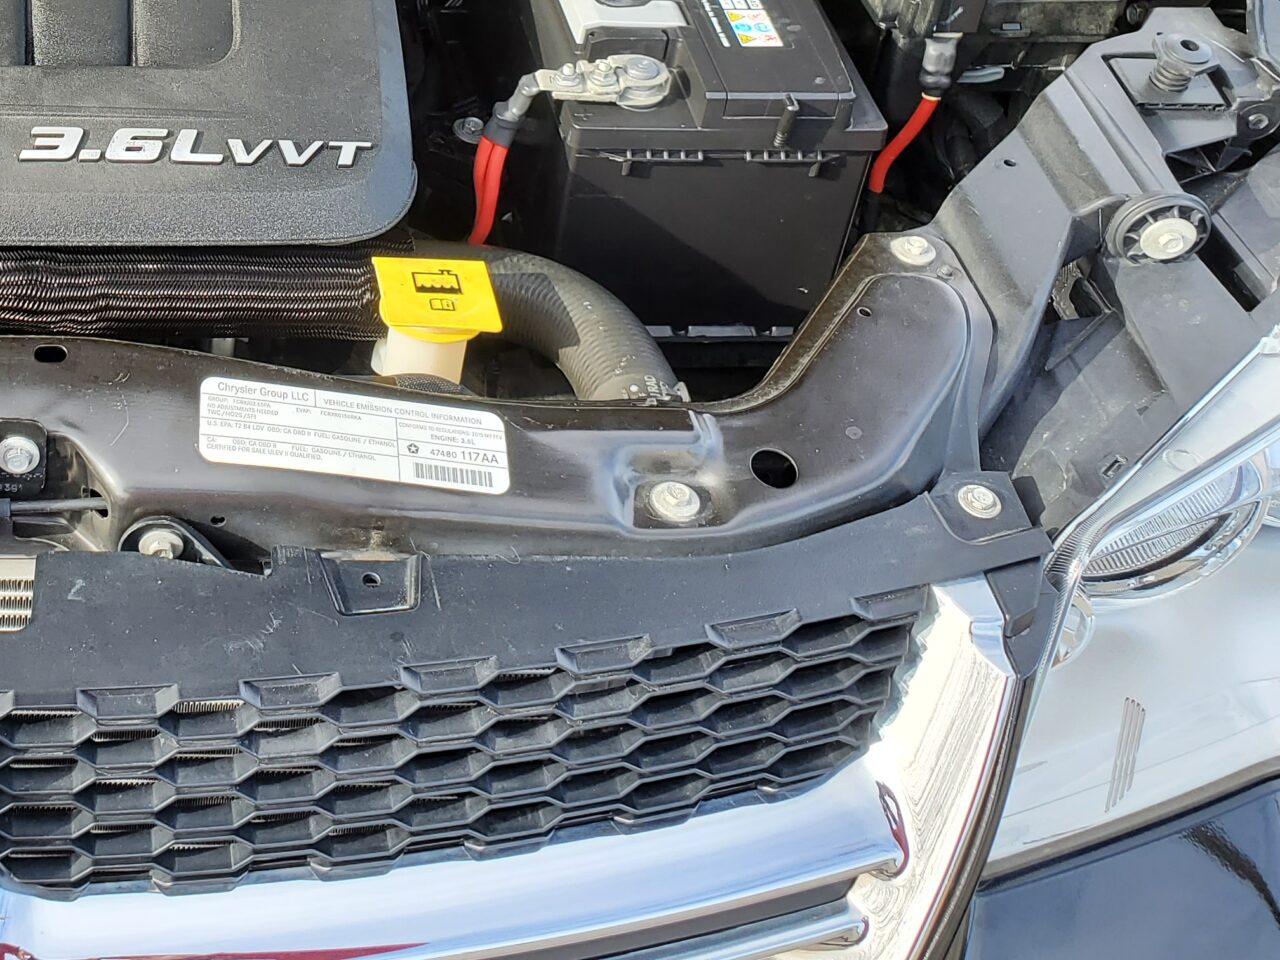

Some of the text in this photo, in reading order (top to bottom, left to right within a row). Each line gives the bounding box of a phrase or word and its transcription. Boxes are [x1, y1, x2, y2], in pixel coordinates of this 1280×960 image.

[18, 126, 373, 168] 3.6L VVT
[217, 381, 310, 402] Chrysler Group LLC
[322, 398, 483, 425] VEHICLE EMISSION CONTROL INFORMATION
[206, 443, 237, 453] CERTIFIED
[251, 447, 266, 455] SALE
[332, 434, 362, 443] GASOLINE
[368, 439, 396, 449] ETHANOL
[311, 447, 341, 457] GASOLINE
[348, 452, 377, 462] ETHANOL
[430, 448, 500, 465] 47480 117AA
